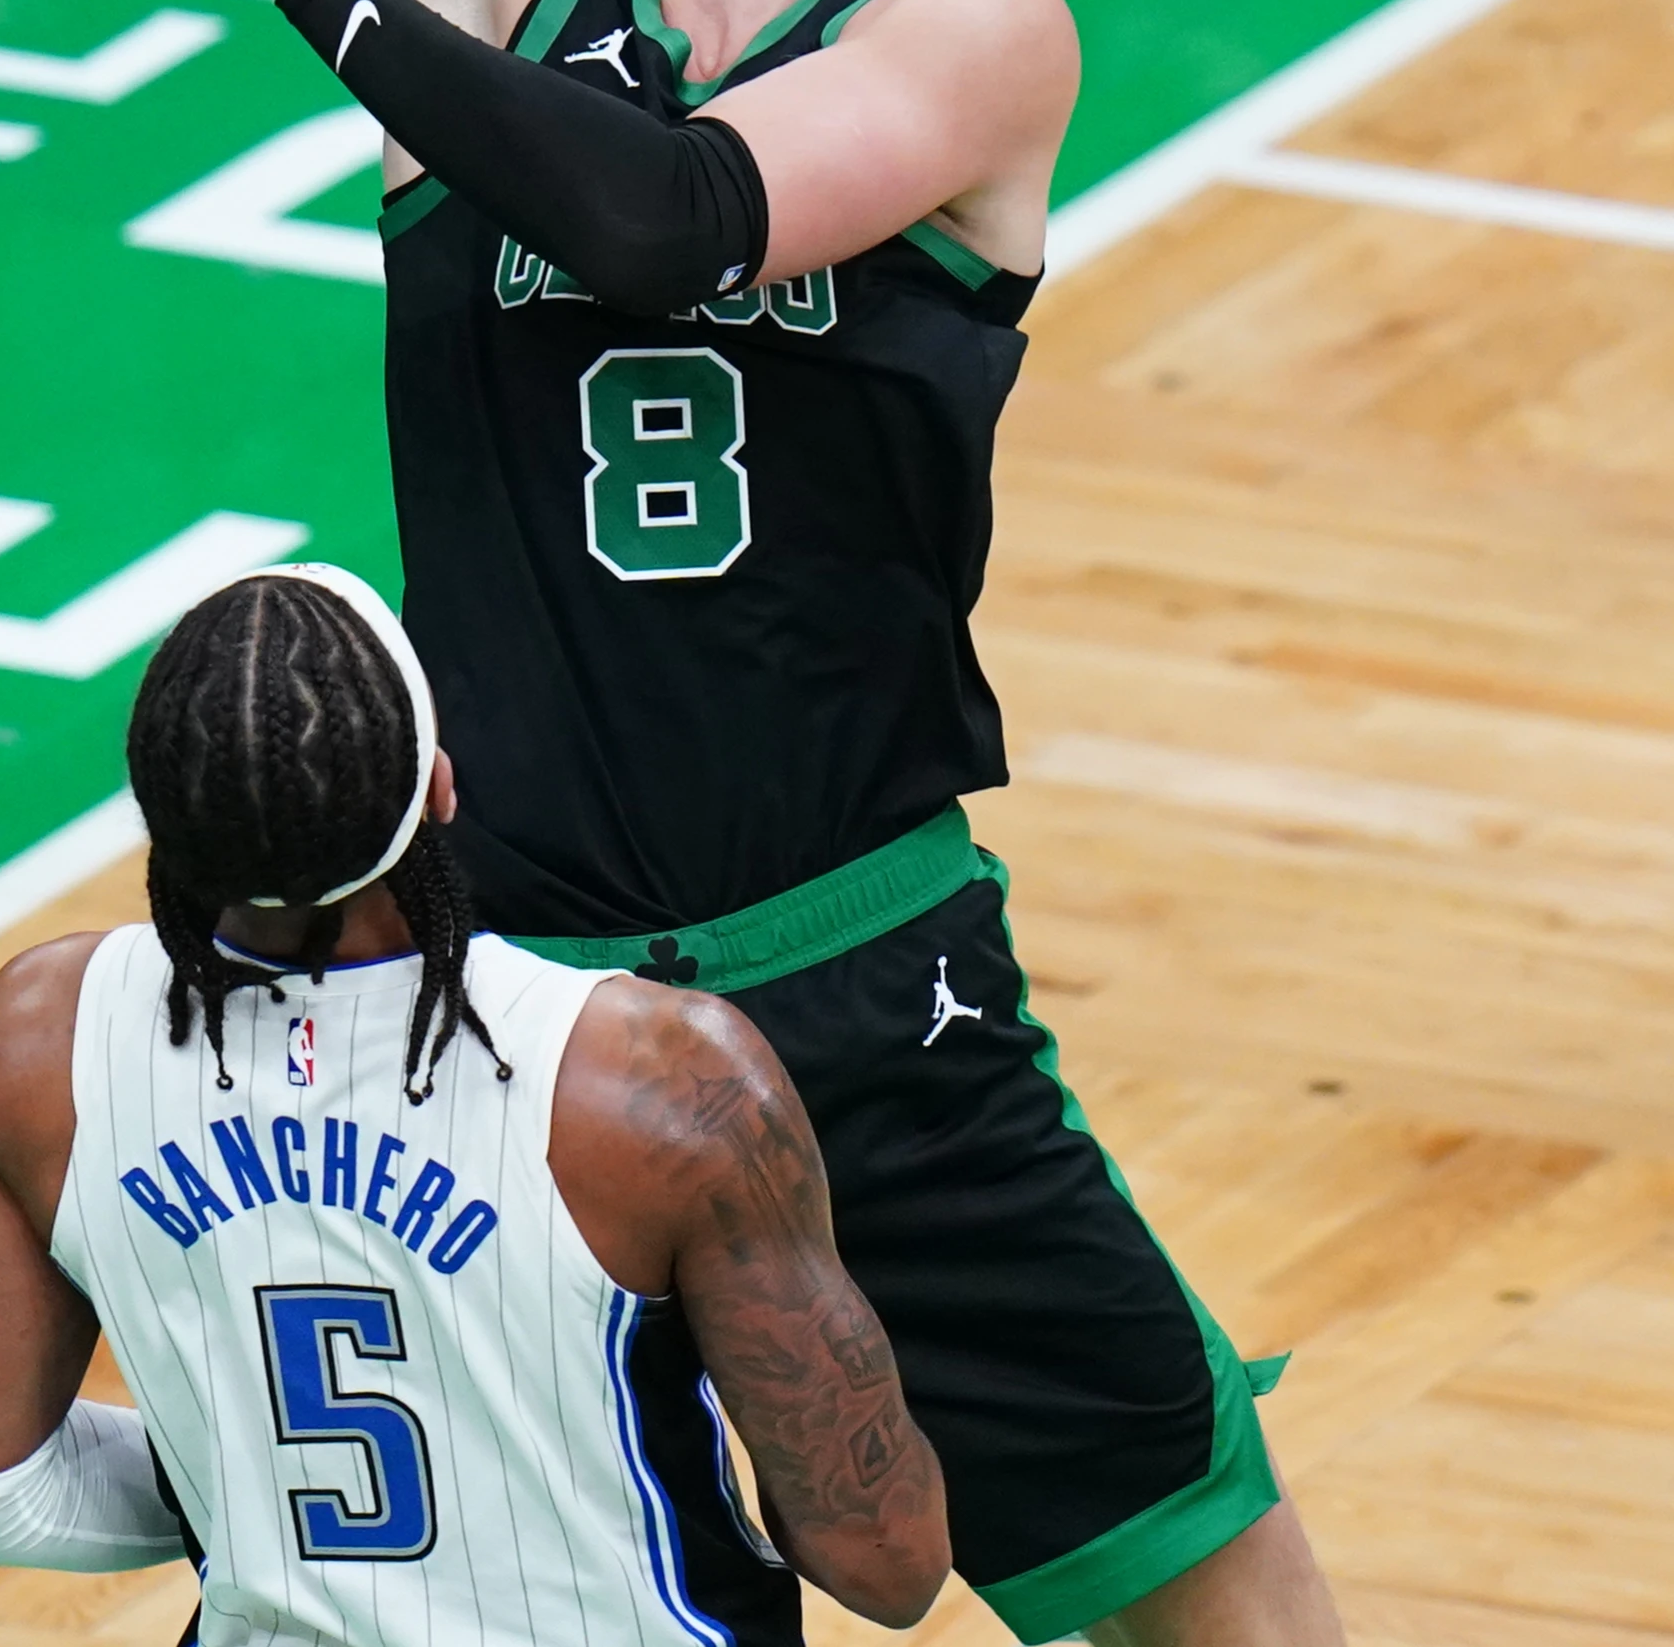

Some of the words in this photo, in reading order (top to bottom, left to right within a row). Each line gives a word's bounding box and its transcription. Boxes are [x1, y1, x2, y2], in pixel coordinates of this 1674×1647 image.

[578, 346, 753, 582] 8
[119, 1114, 499, 1275] BANCHERO
[252, 1283, 439, 1561] 5
